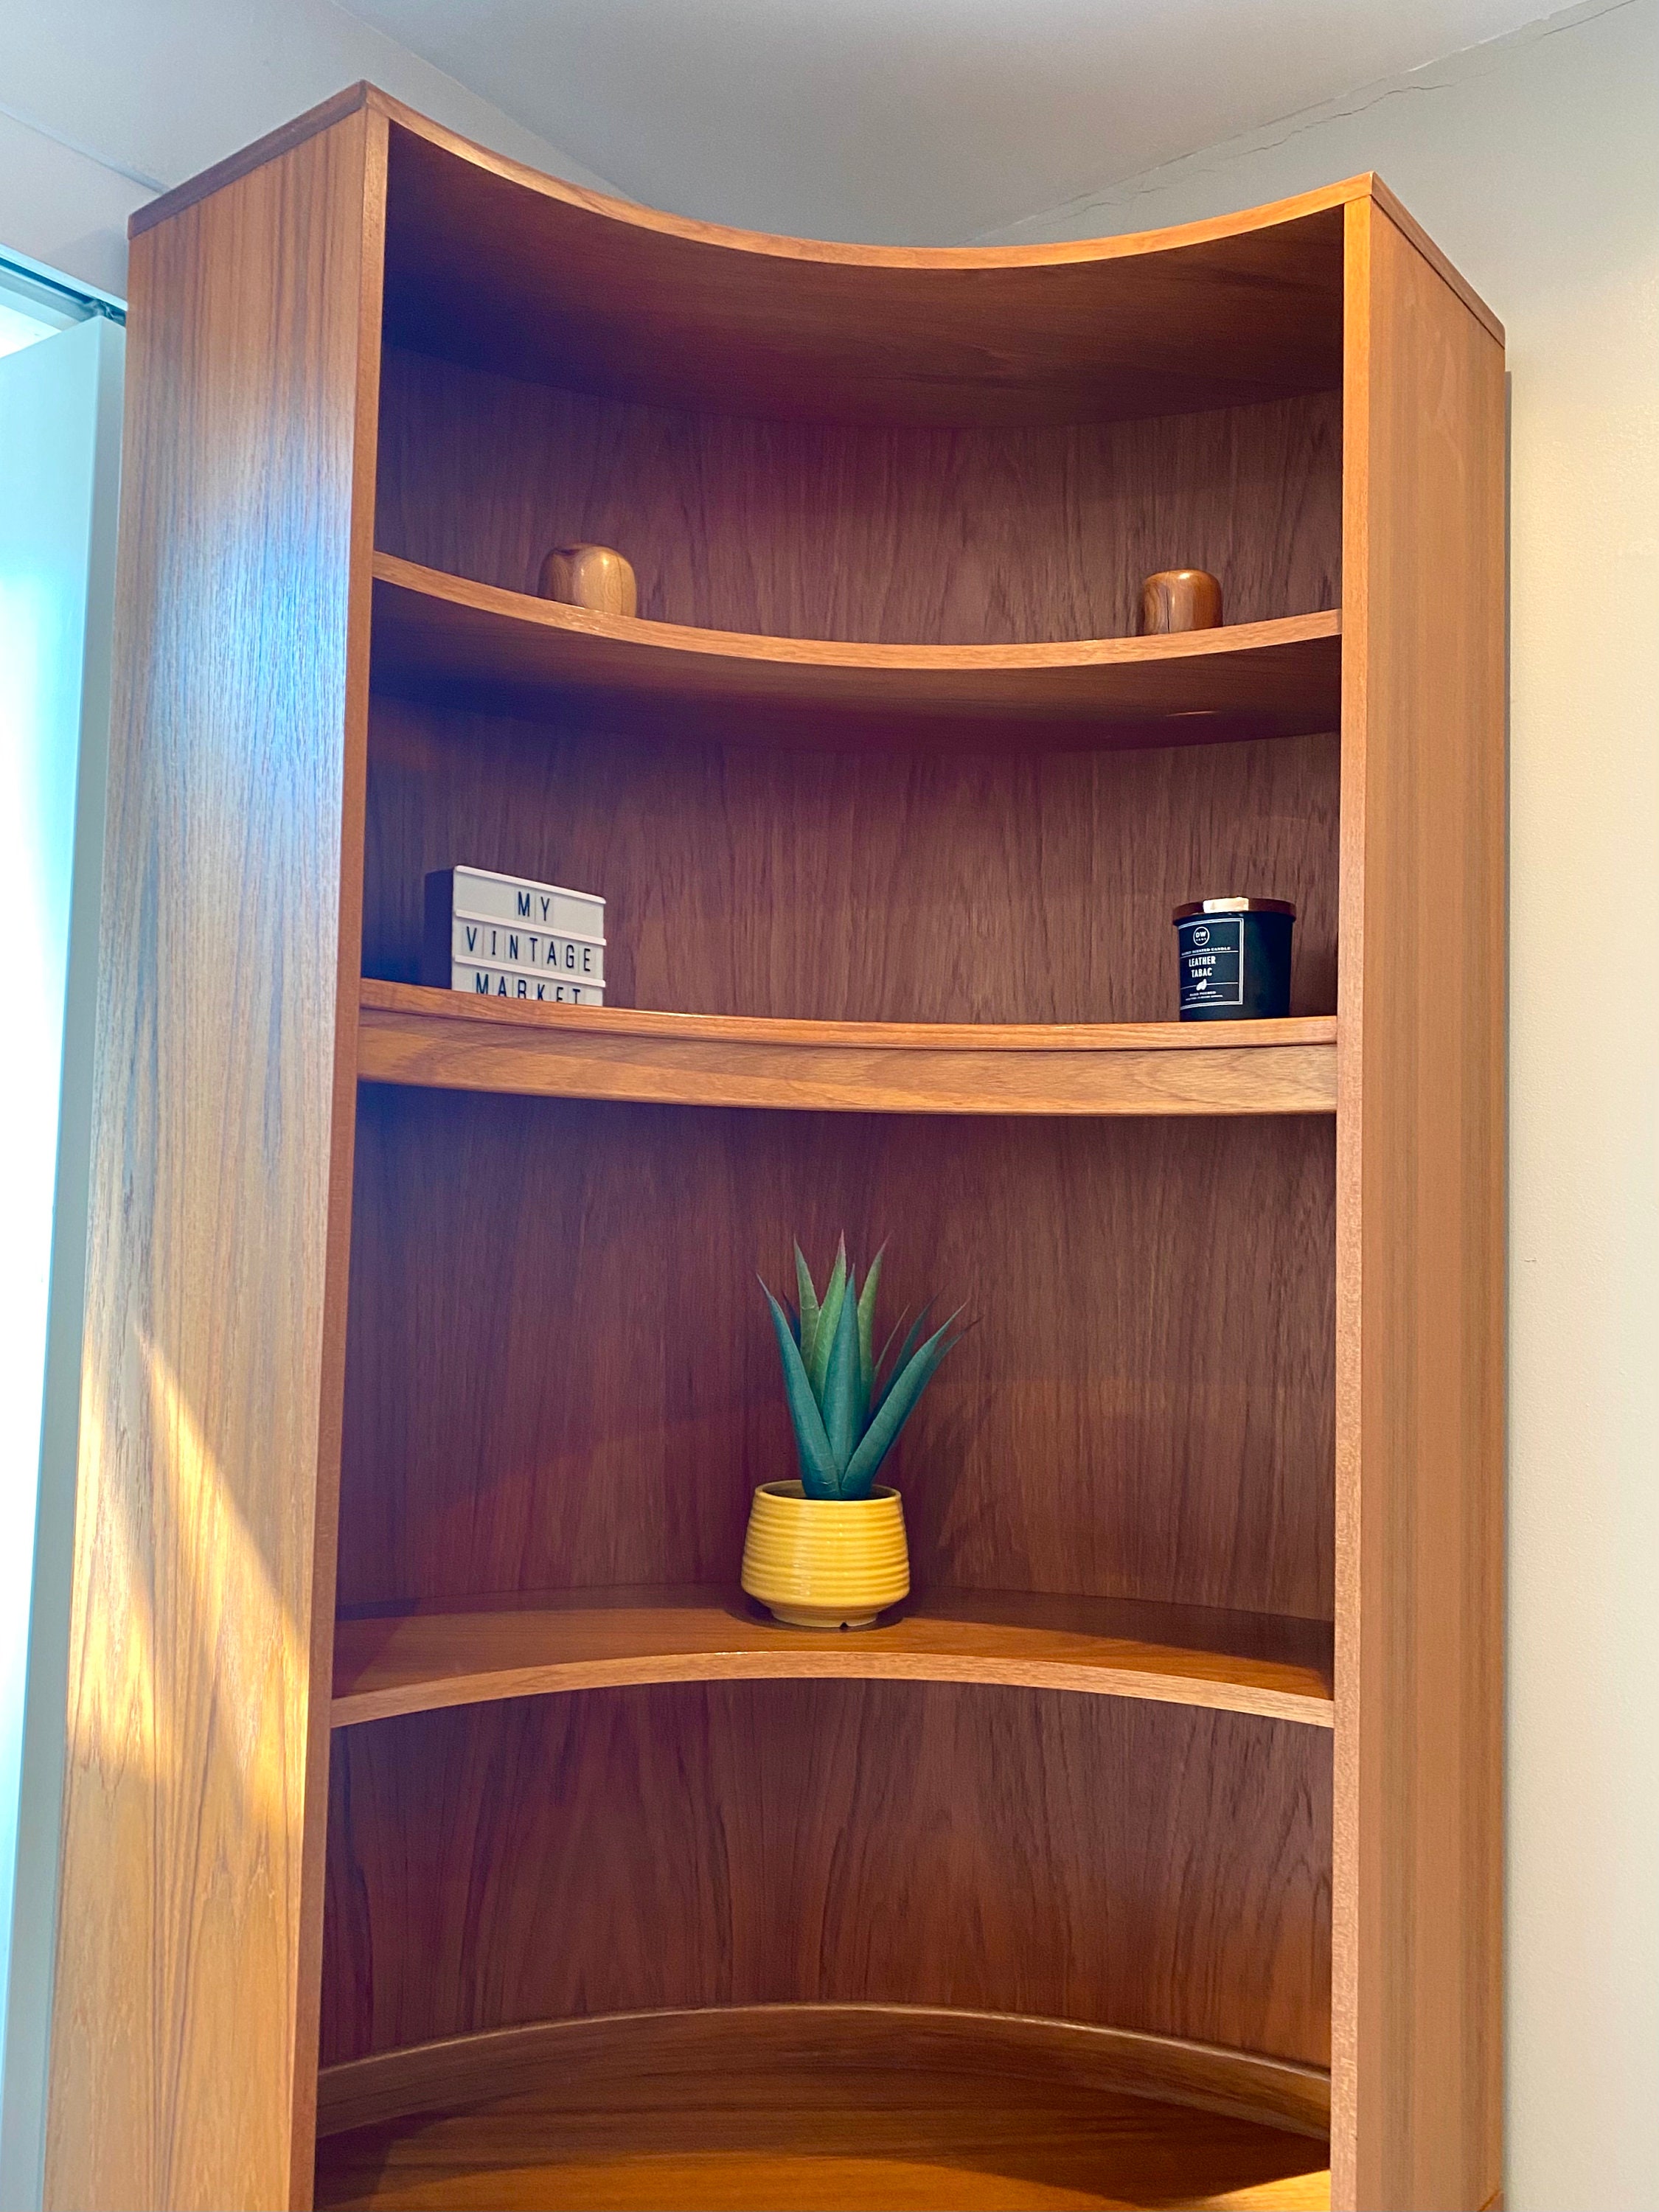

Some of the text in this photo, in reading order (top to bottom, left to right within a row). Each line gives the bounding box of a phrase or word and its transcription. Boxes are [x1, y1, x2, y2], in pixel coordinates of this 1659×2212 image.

[518, 891, 550, 921] MY
[466, 926, 591, 972] VINTAGE
[1189, 956, 1216, 967] LEATHER
[1191, 967, 1212, 978] TABAC
[476, 972, 581, 1004] MARKET
